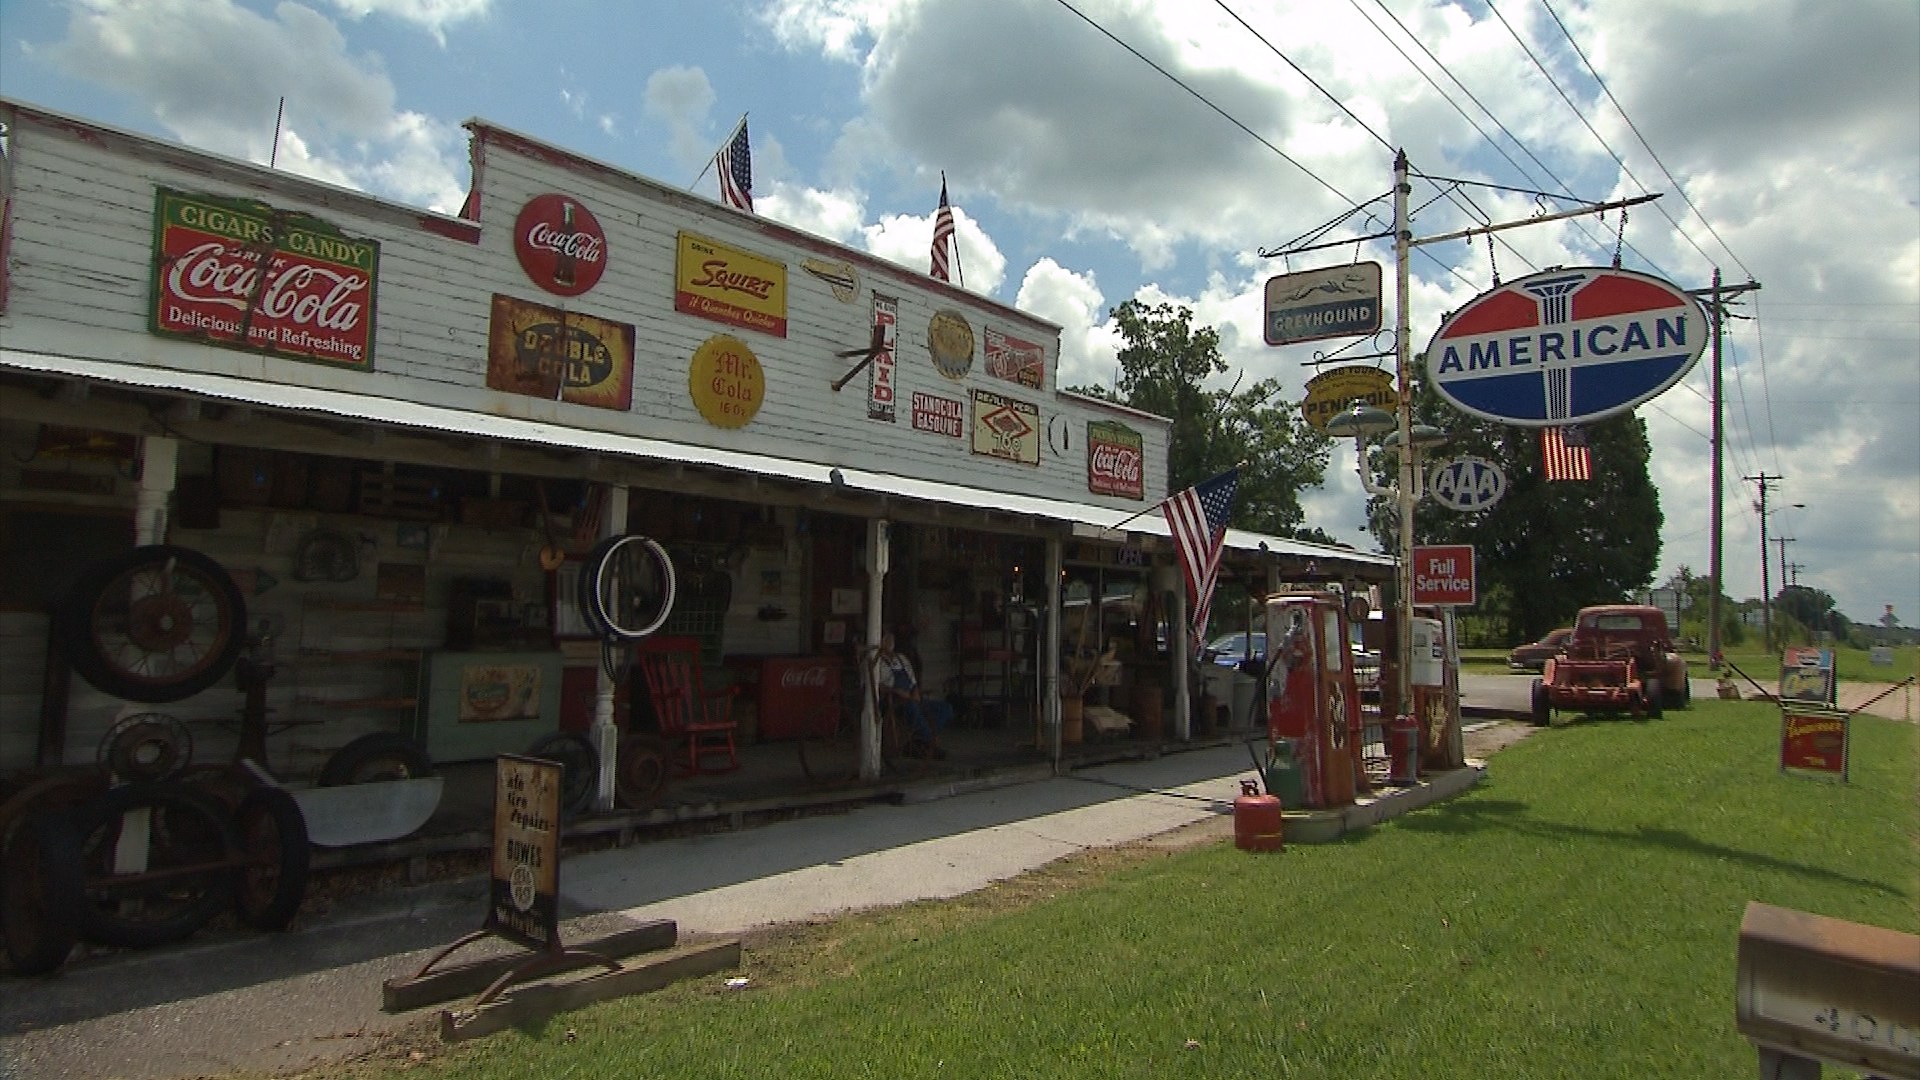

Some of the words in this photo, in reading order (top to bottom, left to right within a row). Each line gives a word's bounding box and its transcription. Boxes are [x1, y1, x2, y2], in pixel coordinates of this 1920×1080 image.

[180, 206, 274, 243] CIGARS
[288, 232, 365, 265] CANDY
[528, 222, 602, 262] Coca-Cola
[226, 247, 287, 269] DRIK
[691, 242, 714, 256] DRINK
[168, 243, 368, 332] Coca-Cola
[1274, 306, 1371, 332] GREYHOUND
[168, 306, 243, 335] Delicious
[248, 325, 277, 341] and
[281, 327, 362, 360] Refreshing
[1438, 315, 1687, 374] AMERICAN
[712, 376, 752, 401] Cola
[913, 393, 961, 420] STANOCOLA
[1307, 390, 1395, 416] PENNOIL
[1438, 460, 1497, 506] AAA
[1429, 558, 1455, 575] Full
[1416, 574, 1470, 592] Service
